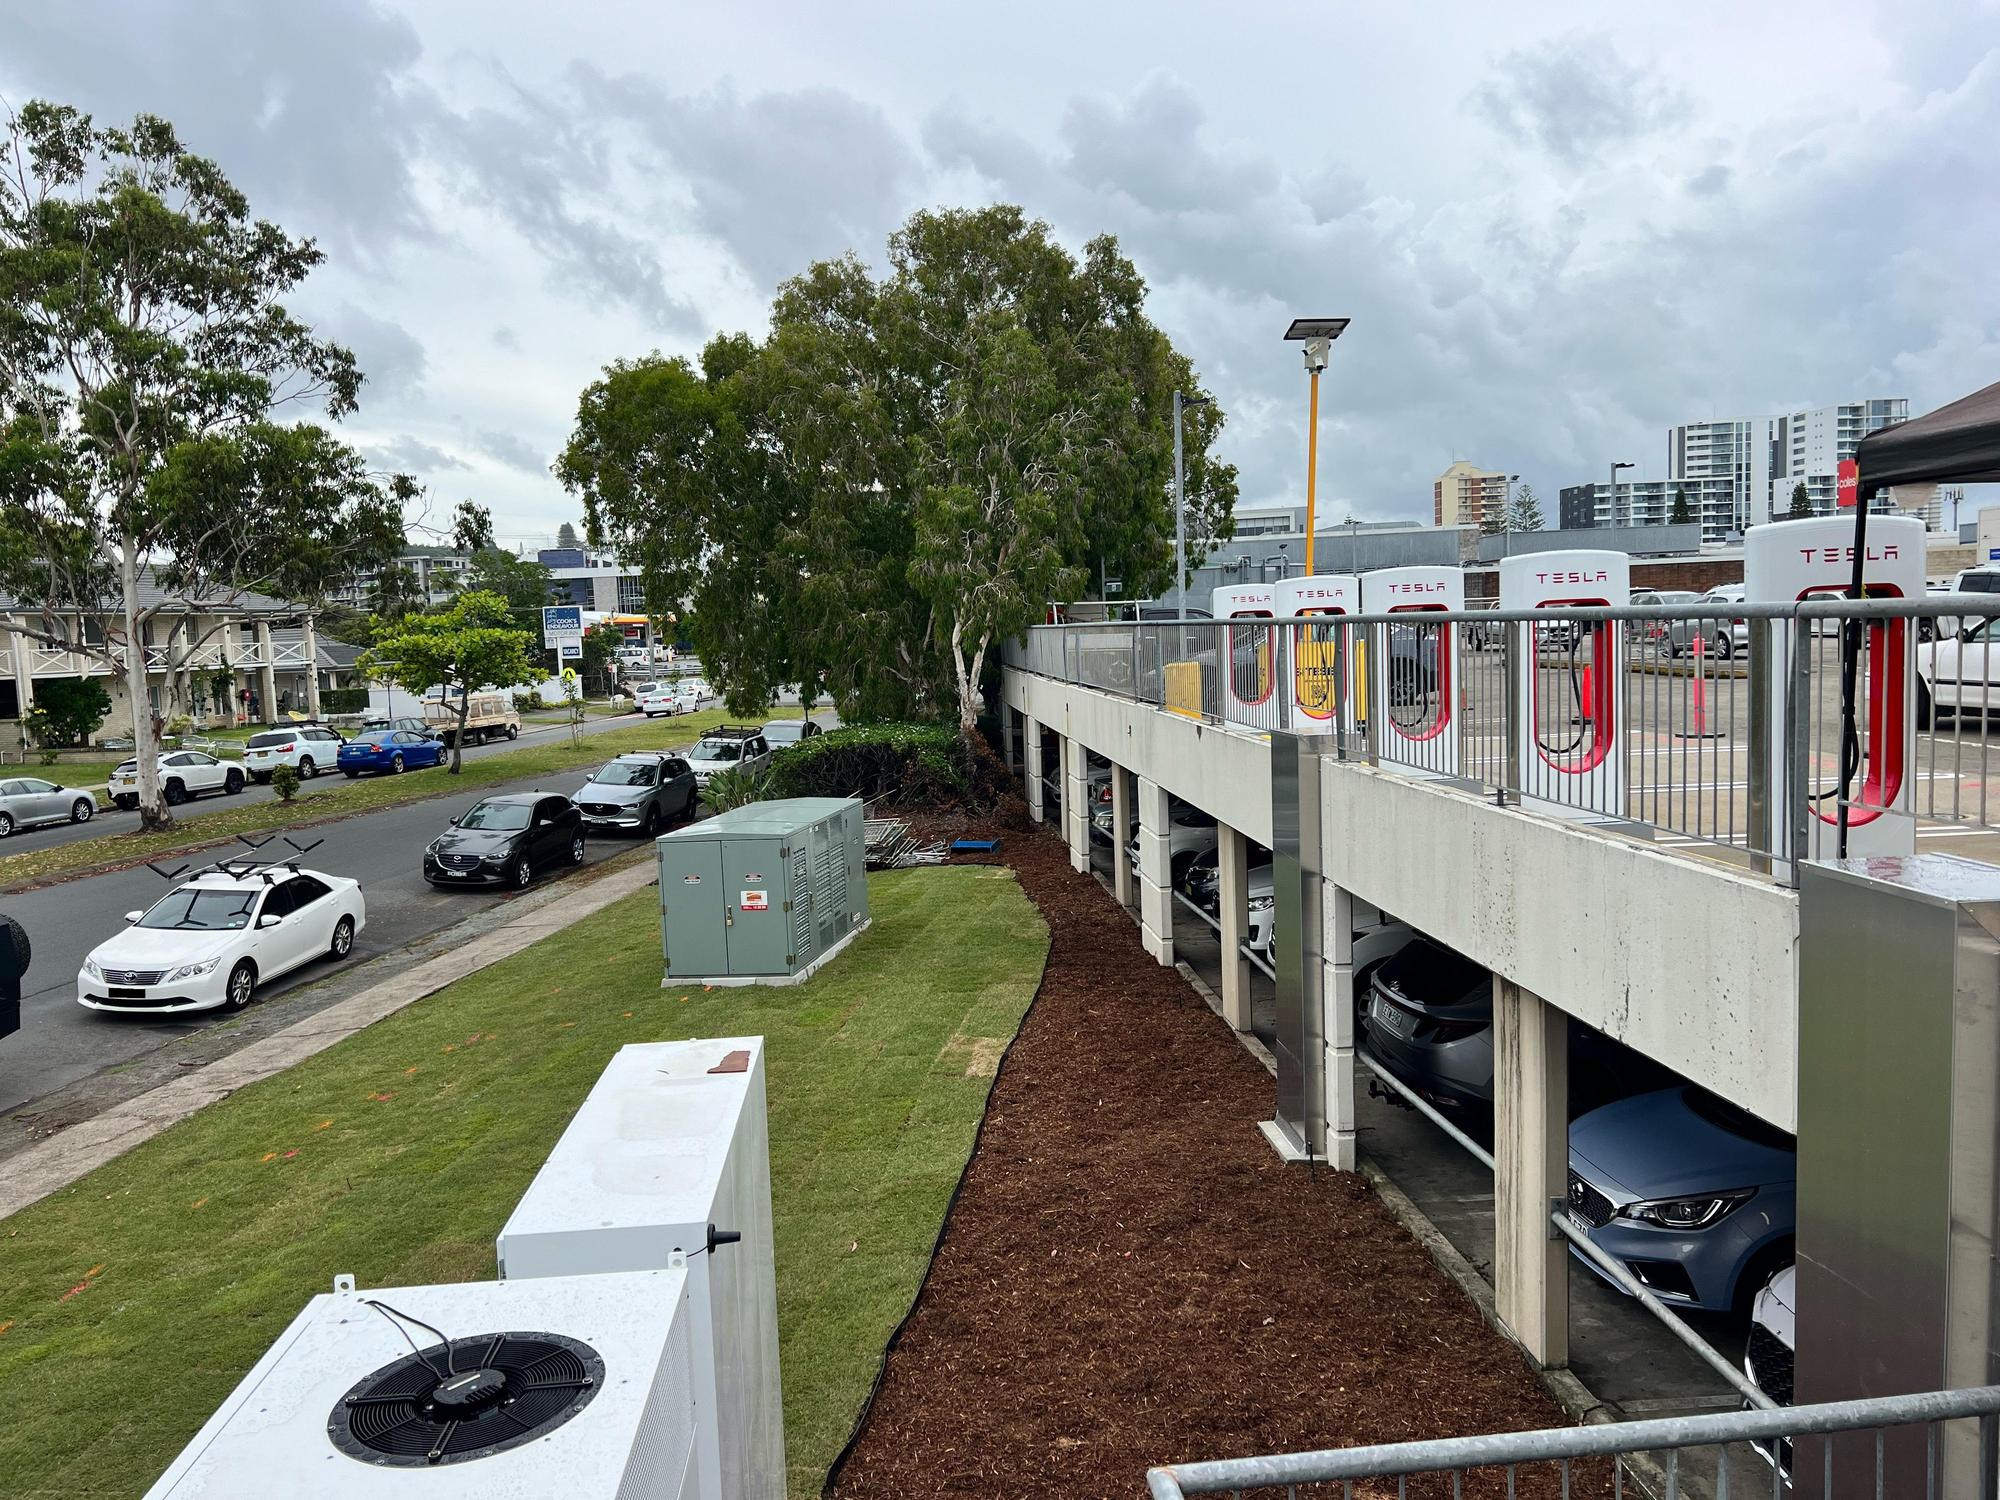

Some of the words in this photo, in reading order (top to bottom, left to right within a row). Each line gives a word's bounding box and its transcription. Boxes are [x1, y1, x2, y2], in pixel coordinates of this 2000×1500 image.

[1839, 476, 1857, 488] coles
[1800, 546, 1898, 563] TESLA
[1536, 572, 1607, 584] TESLA
[1388, 583, 1446, 593] TESLA
[1231, 595, 1271, 603] TESLA
[1296, 589, 1343, 599] TESLA
